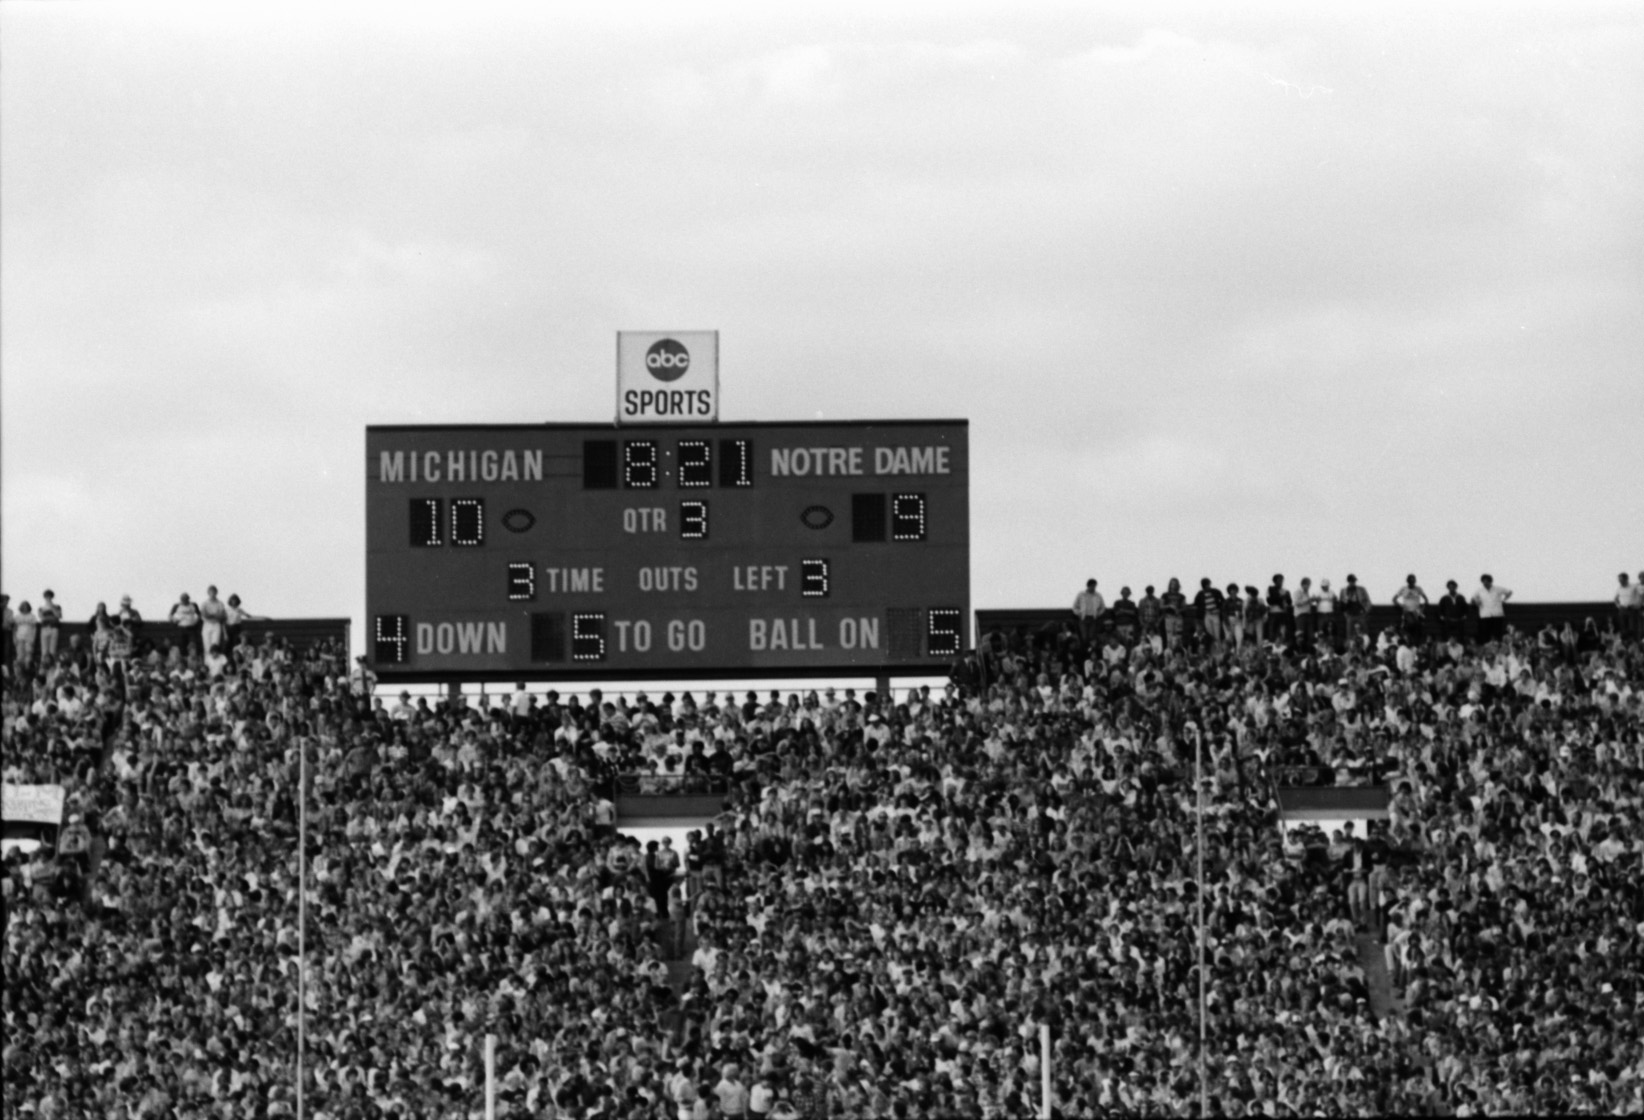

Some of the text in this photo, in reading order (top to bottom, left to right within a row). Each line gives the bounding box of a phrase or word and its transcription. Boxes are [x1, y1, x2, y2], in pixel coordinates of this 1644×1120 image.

[647, 349, 689, 369] abc
[625, 389, 711, 415] SPORTS
[379, 449, 543, 482] MICHIGAN
[771, 446, 950, 476] NOTRE DAME
[425, 499, 483, 545] 10
[623, 501, 707, 538] QTR 3
[893, 494, 925, 540] 9
[508, 560, 828, 599] 3 TIME OUTS LEFT 3
[376, 614, 706, 662] 4 DOWN 5 TO GO
[749, 610, 961, 655] BALL ON 5
